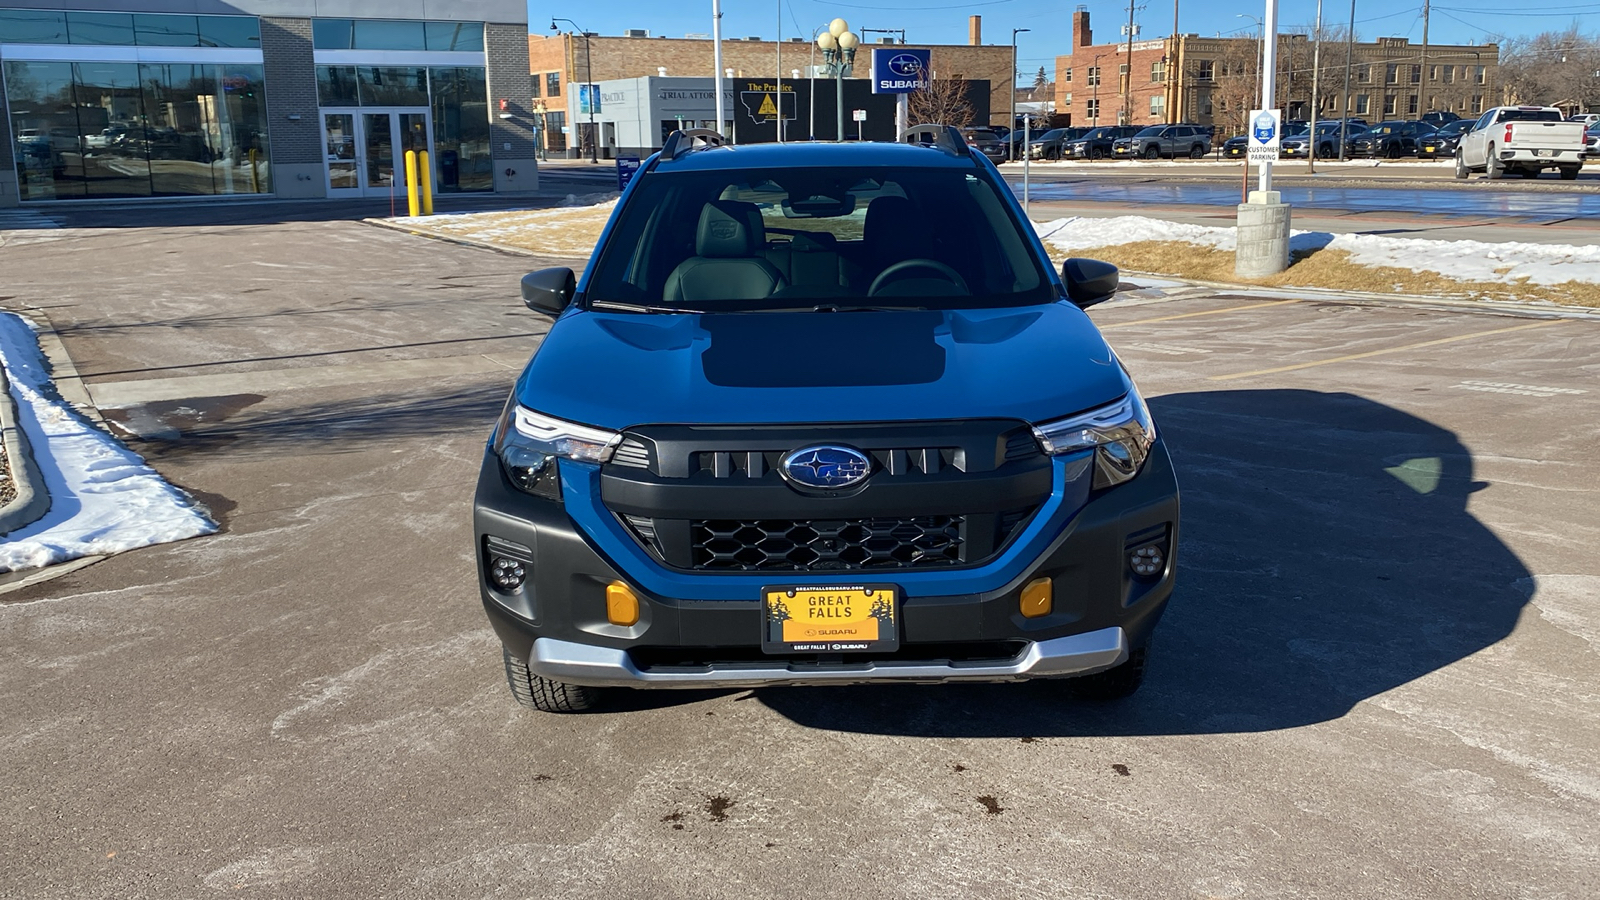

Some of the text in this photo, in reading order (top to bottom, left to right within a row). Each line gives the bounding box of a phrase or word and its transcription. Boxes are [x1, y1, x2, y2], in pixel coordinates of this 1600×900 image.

[747, 83, 792, 91] The Pratice
[880, 80, 928, 89] SUBARU
[601, 92, 625, 103] PRACTICE
[662, 91, 734, 100] TRIAL ATTORYS
[808, 595, 852, 606] GREAT
[809, 606, 852, 618] FALLS
